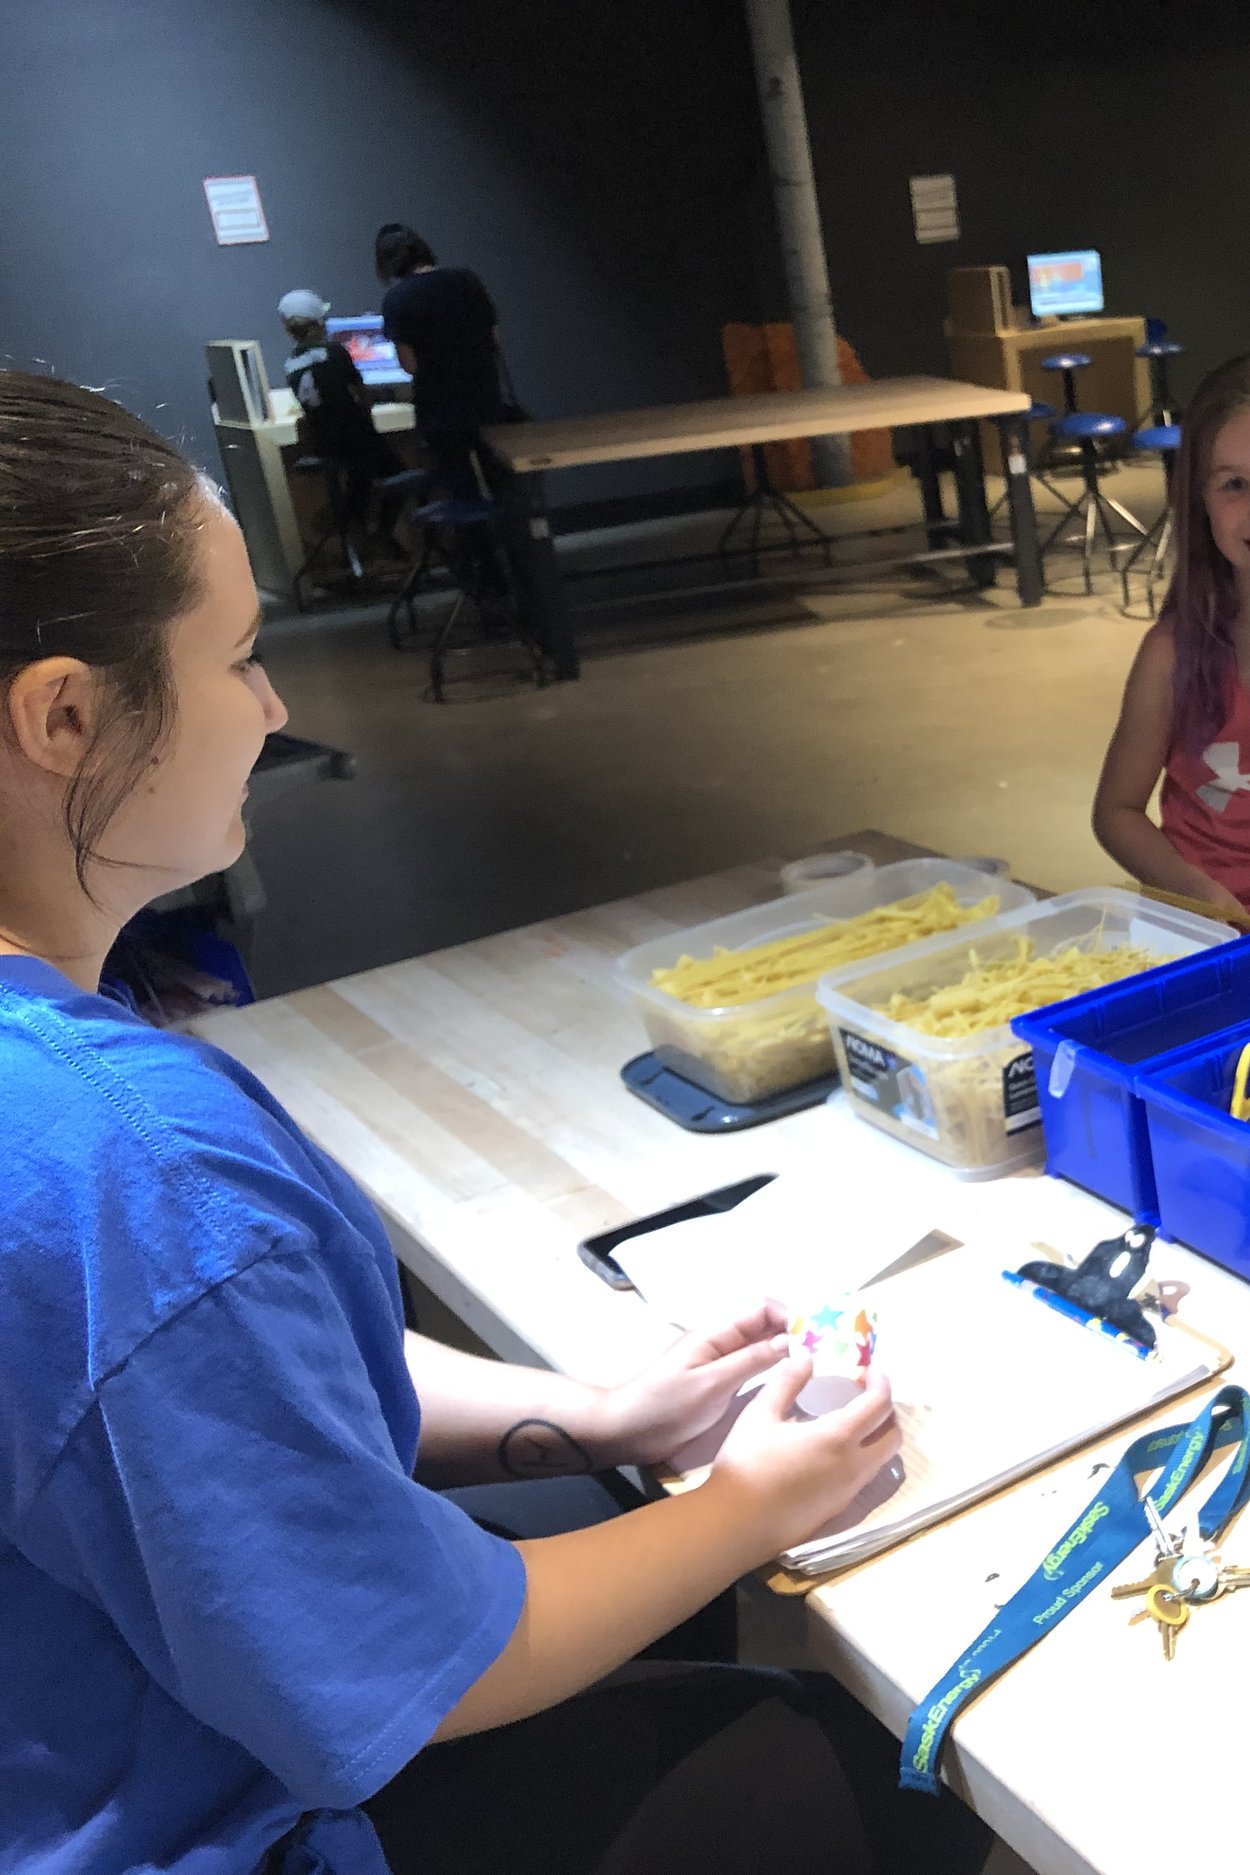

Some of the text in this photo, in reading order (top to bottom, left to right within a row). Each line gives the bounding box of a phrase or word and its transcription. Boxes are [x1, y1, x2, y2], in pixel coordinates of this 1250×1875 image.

[1042, 1501, 1110, 1577] SaskEnergy
[1032, 1561, 1104, 1625] Proud Sponsor
[912, 1672, 981, 1773] SaskEnergy
